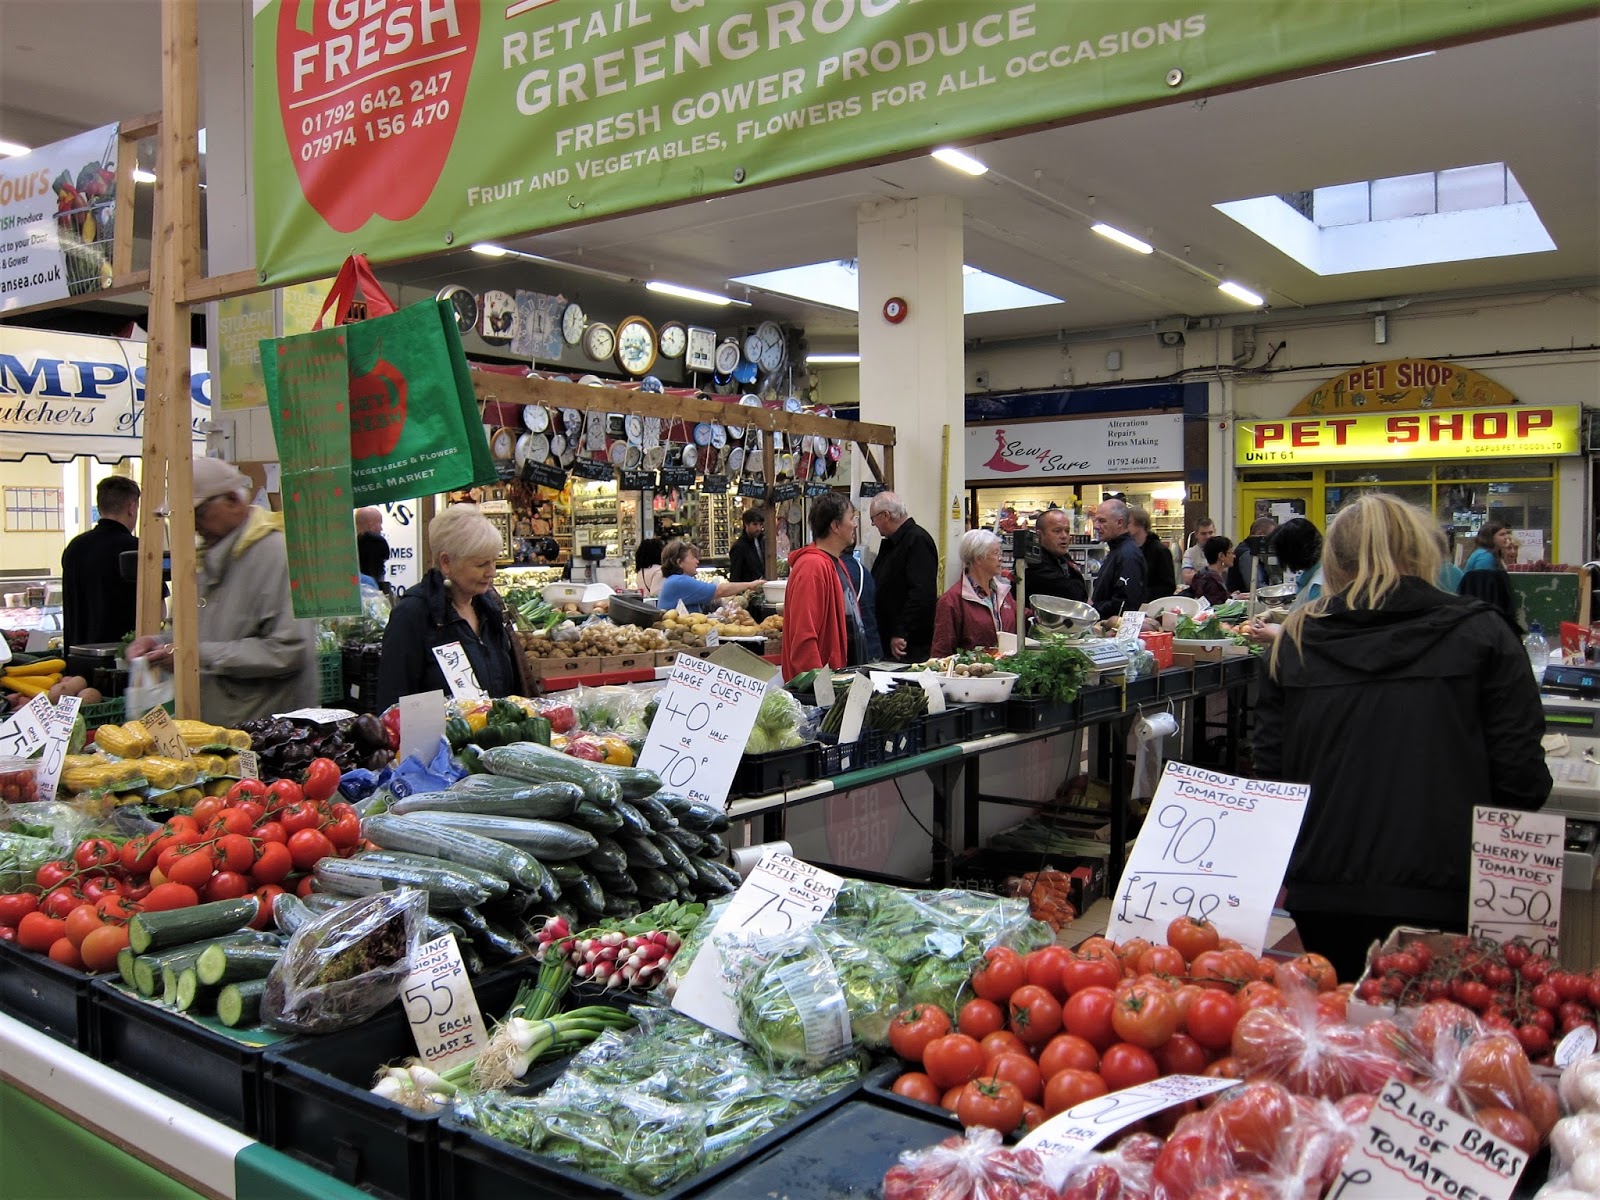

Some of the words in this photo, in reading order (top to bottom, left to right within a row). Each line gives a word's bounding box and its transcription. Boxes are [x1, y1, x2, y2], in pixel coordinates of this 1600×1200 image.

[292, 0, 462, 93] FRESH
[502, 0, 652, 70] RETAIL
[555, 106, 662, 156] FRESH
[672, 68, 805, 126] GOWER
[816, 4, 1037, 88] PRODUCE
[302, 102, 355, 136] 01792
[360, 86, 402, 112] 642
[410, 70, 453, 101] 247
[467, 180, 522, 207] FRUIT
[528, 168, 570, 193] AND
[576, 131, 728, 181] VEGETABLES,
[738, 96, 861, 143] FLOWERS
[872, 80, 926, 112] FOR
[937, 64, 996, 97] ALL
[1006, 14, 1207, 78] OCCASIONS
[301, 130, 357, 162] 07974
[365, 115, 405, 142] 156
[411, 100, 450, 129] 470
[0, 167, 50, 207] ours
[16, 212, 44, 227] Produce
[8, 254, 29, 268] Gower
[0, 264, 61, 294] ansea.co.uk
[1349, 365, 1387, 391] PET
[1398, 363, 1453, 388] SHOP
[1108, 420, 1148, 428] Alterations
[1108, 430, 1136, 438] Repairs
[1254, 419, 1357, 450] PET
[1387, 409, 1553, 443] SHOP
[1130, 438, 1159, 446] Making
[1246, 452, 1276, 461] UNIT
[1281, 450, 1294, 460] 61
[353, 459, 408, 477] VEGETABLES
[411, 456, 418, 464] &
[420, 446, 458, 461] FLOWERS
[1001, 440, 1041, 458] Sew
[1041, 455, 1091, 472] Sure
[1107, 458, 1129, 466] 01792
[1131, 456, 1157, 465] 464012
[352, 482, 383, 494] NSEA
[386, 468, 435, 487] MARKET
[671, 668, 704, 688] LARGE
[710, 682, 743, 703] CUES
[678, 654, 715, 674] LOVELY
[716, 668, 767, 696] ENGLISH
[665, 691, 710, 731] 40
[681, 736, 692, 746] OR
[709, 729, 729, 741] HALF
[659, 744, 697, 788] 70
[1166, 762, 1240, 787] DELICIOUS
[1245, 780, 1309, 798] ENGLISH
[688, 789, 711, 803] EACH
[1177, 780, 1259, 810] TOMATOES
[1476, 809, 1522, 826] VERY
[1158, 804, 1216, 865] 90
[1500, 827, 1560, 845] SWEET
[772, 852, 819, 876] FRESH
[1199, 860, 1214, 869] LB
[1472, 841, 1529, 861] CHERRY
[1533, 853, 1563, 869] VINE
[756, 857, 800, 882] LITTLE
[804, 878, 837, 899] GEMS
[1478, 858, 1555, 884] TOMATOES
[789, 886, 820, 902] ONLY
[420, 938, 451, 957] ING
[432, 959, 461, 974] ONLY
[405, 973, 454, 1025] 55
[438, 1015, 472, 1034] EACH
[425, 1038, 459, 1058] CLASS
[1065, 1127, 1097, 1138] EACH
[1382, 1082, 1406, 1110] 2
[1407, 1103, 1450, 1133] LBS
[1460, 1128, 1522, 1177] BAGS
[1418, 1134, 1450, 1154] OF
